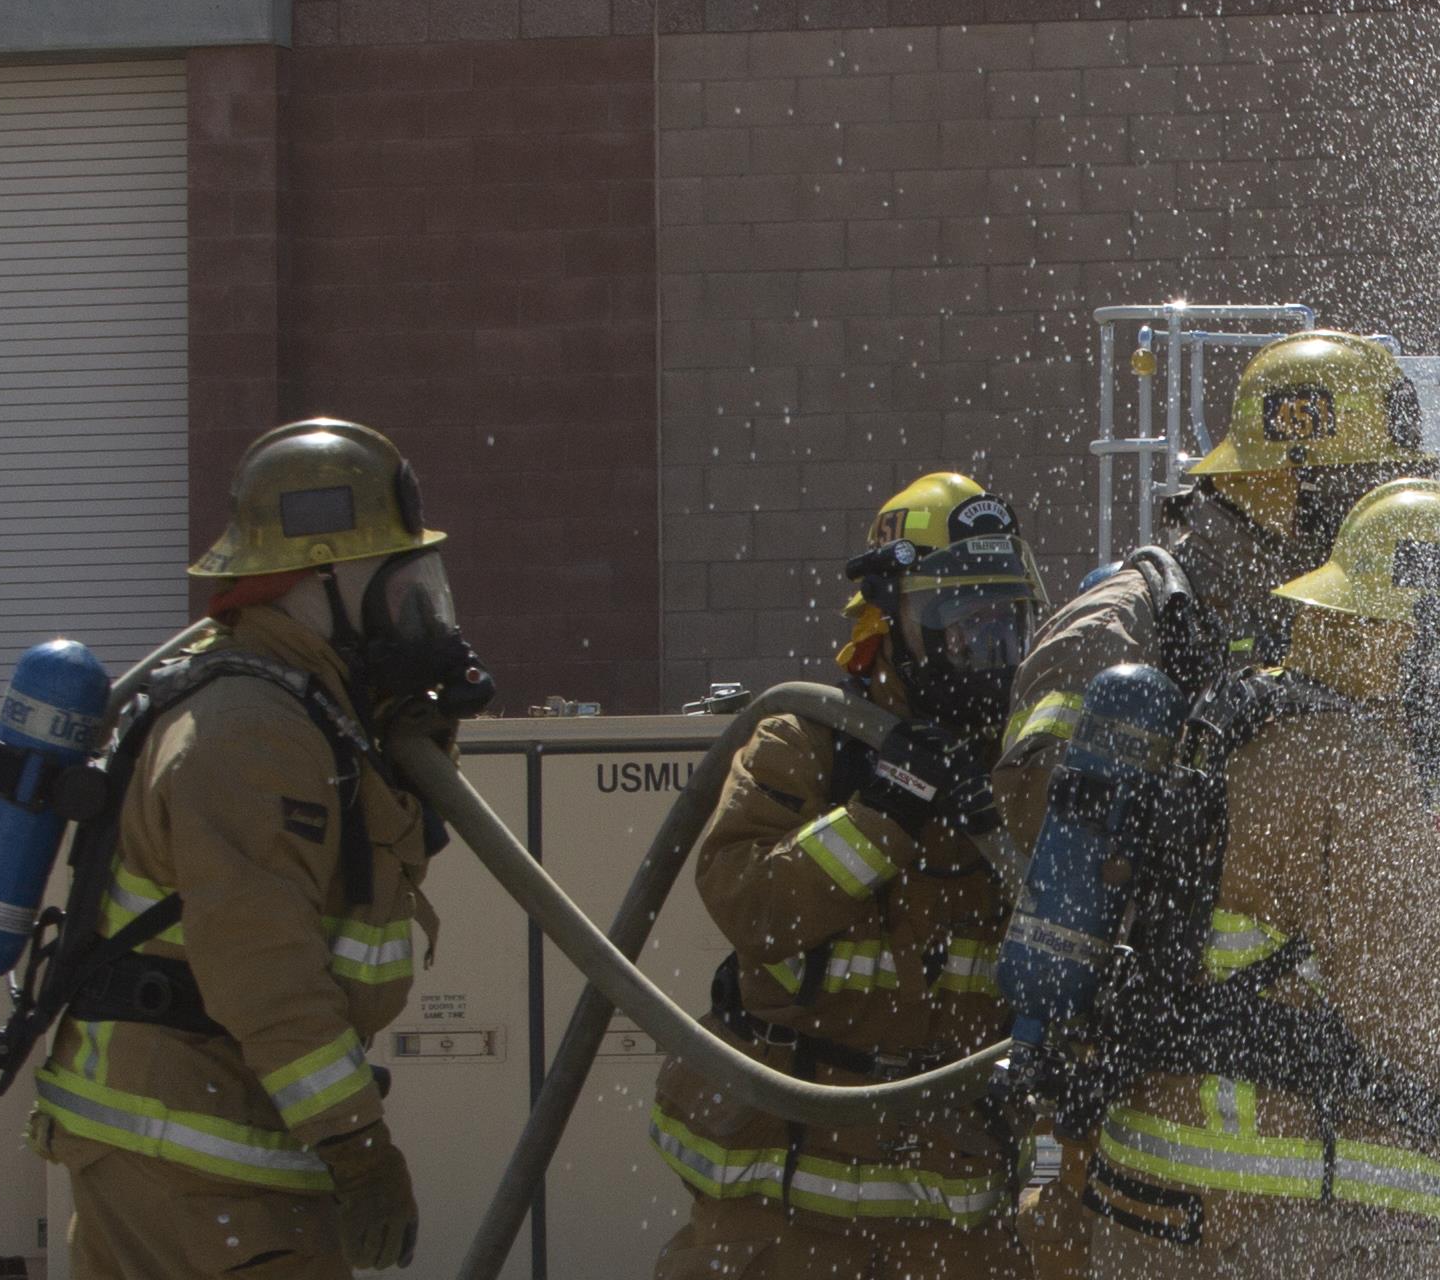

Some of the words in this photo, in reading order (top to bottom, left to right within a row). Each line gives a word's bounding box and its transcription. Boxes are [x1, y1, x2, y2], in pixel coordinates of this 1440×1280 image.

[964, 501, 993, 520] CENTER
[49, 710, 91, 742] Drä
[597, 762, 693, 793] USMU
[1032, 926, 1077, 953] Dräger
